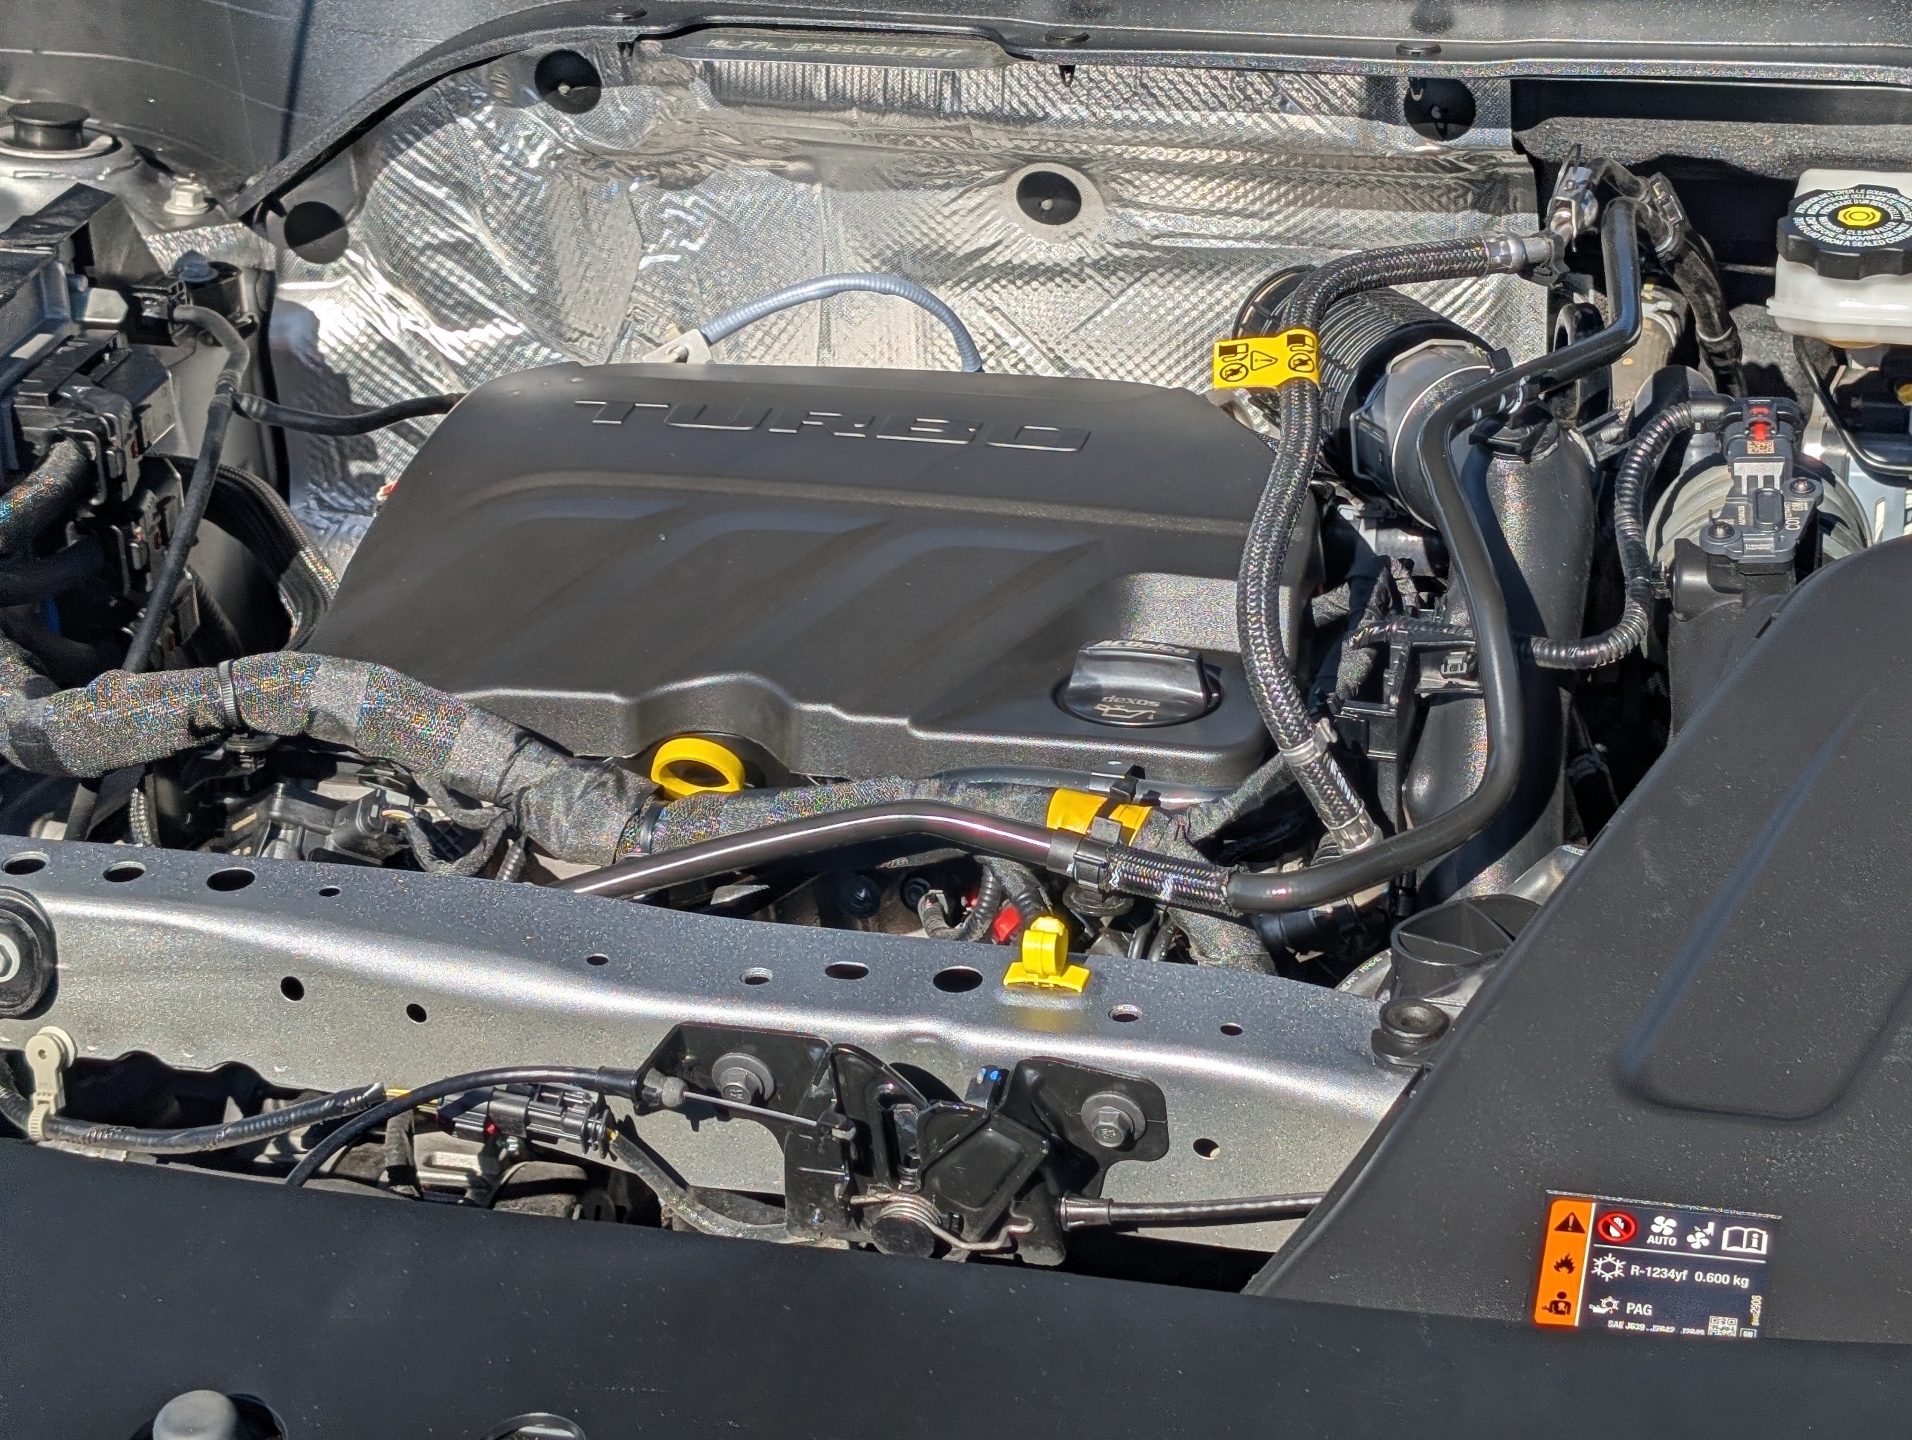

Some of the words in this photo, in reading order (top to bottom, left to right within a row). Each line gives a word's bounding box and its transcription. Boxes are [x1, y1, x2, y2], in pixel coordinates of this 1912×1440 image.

[1818, 235, 1844, 246] FROM
[1851, 239, 1887, 247] SEALED
[575, 400, 1091, 453] TURBO
[1101, 694, 1160, 708] dexos
[1646, 1234, 1678, 1247] AUTO
[1630, 1264, 1689, 1281] R-1234yf
[1694, 1271, 1730, 1285] 0.600
[1732, 1272, 1750, 1288] kg
[1625, 1302, 1653, 1316] PAG
[1607, 1319, 1624, 1329] SAE
